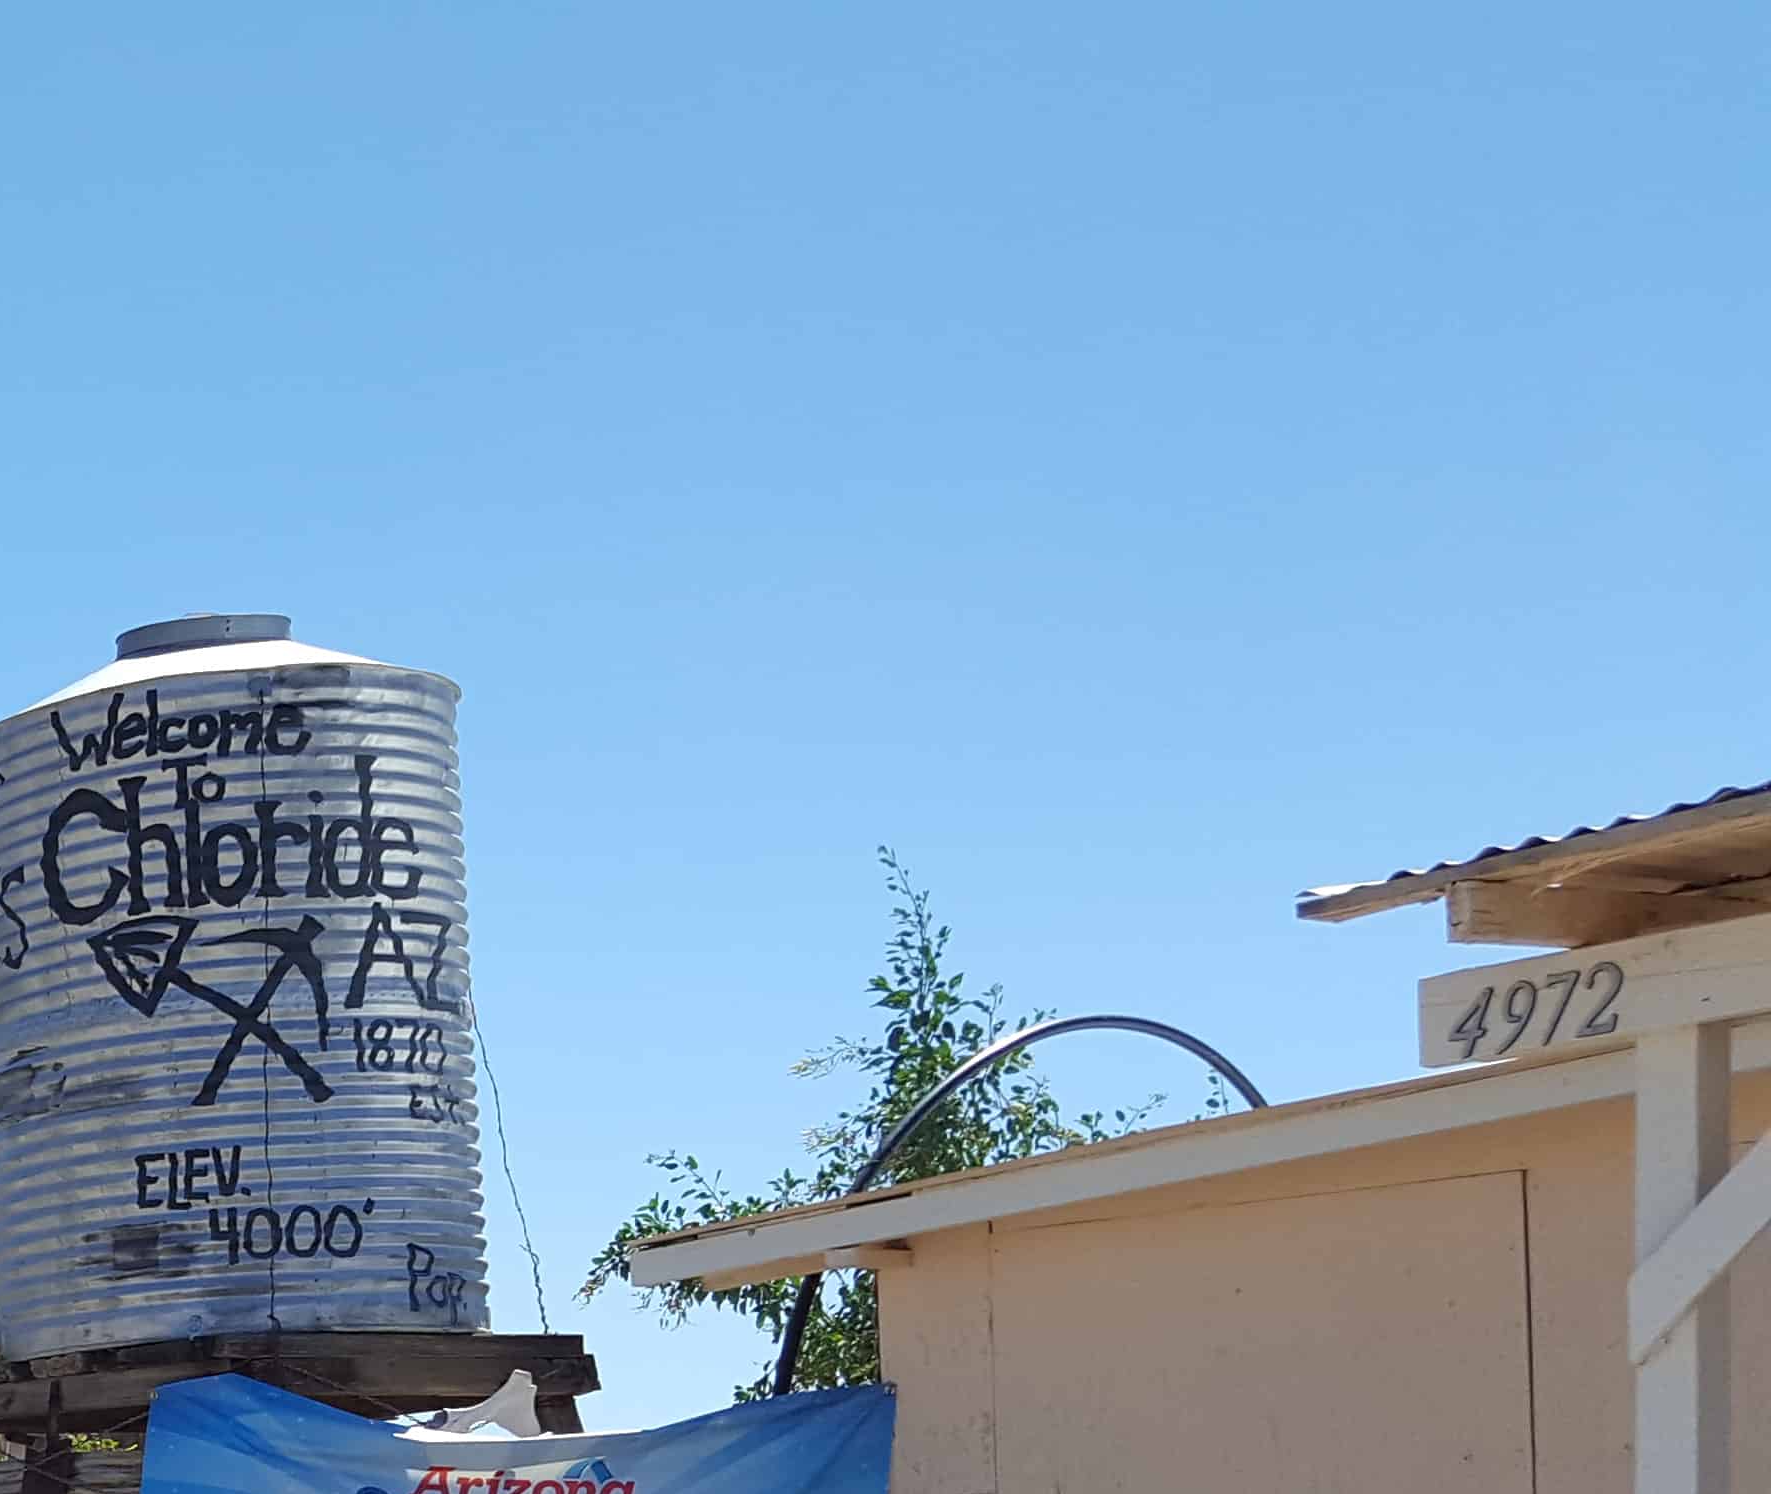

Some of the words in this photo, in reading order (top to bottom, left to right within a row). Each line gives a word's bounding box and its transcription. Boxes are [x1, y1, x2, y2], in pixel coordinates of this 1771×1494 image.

[51, 689, 311, 771] Welcome
[162, 754, 226, 808] To
[41, 754, 423, 924] Chloride
[344, 902, 466, 1015] AZ
[353, 1017, 446, 1074] 1870
[1447, 960, 1625, 1060] 4972
[134, 1145, 251, 1209] ELEV.
